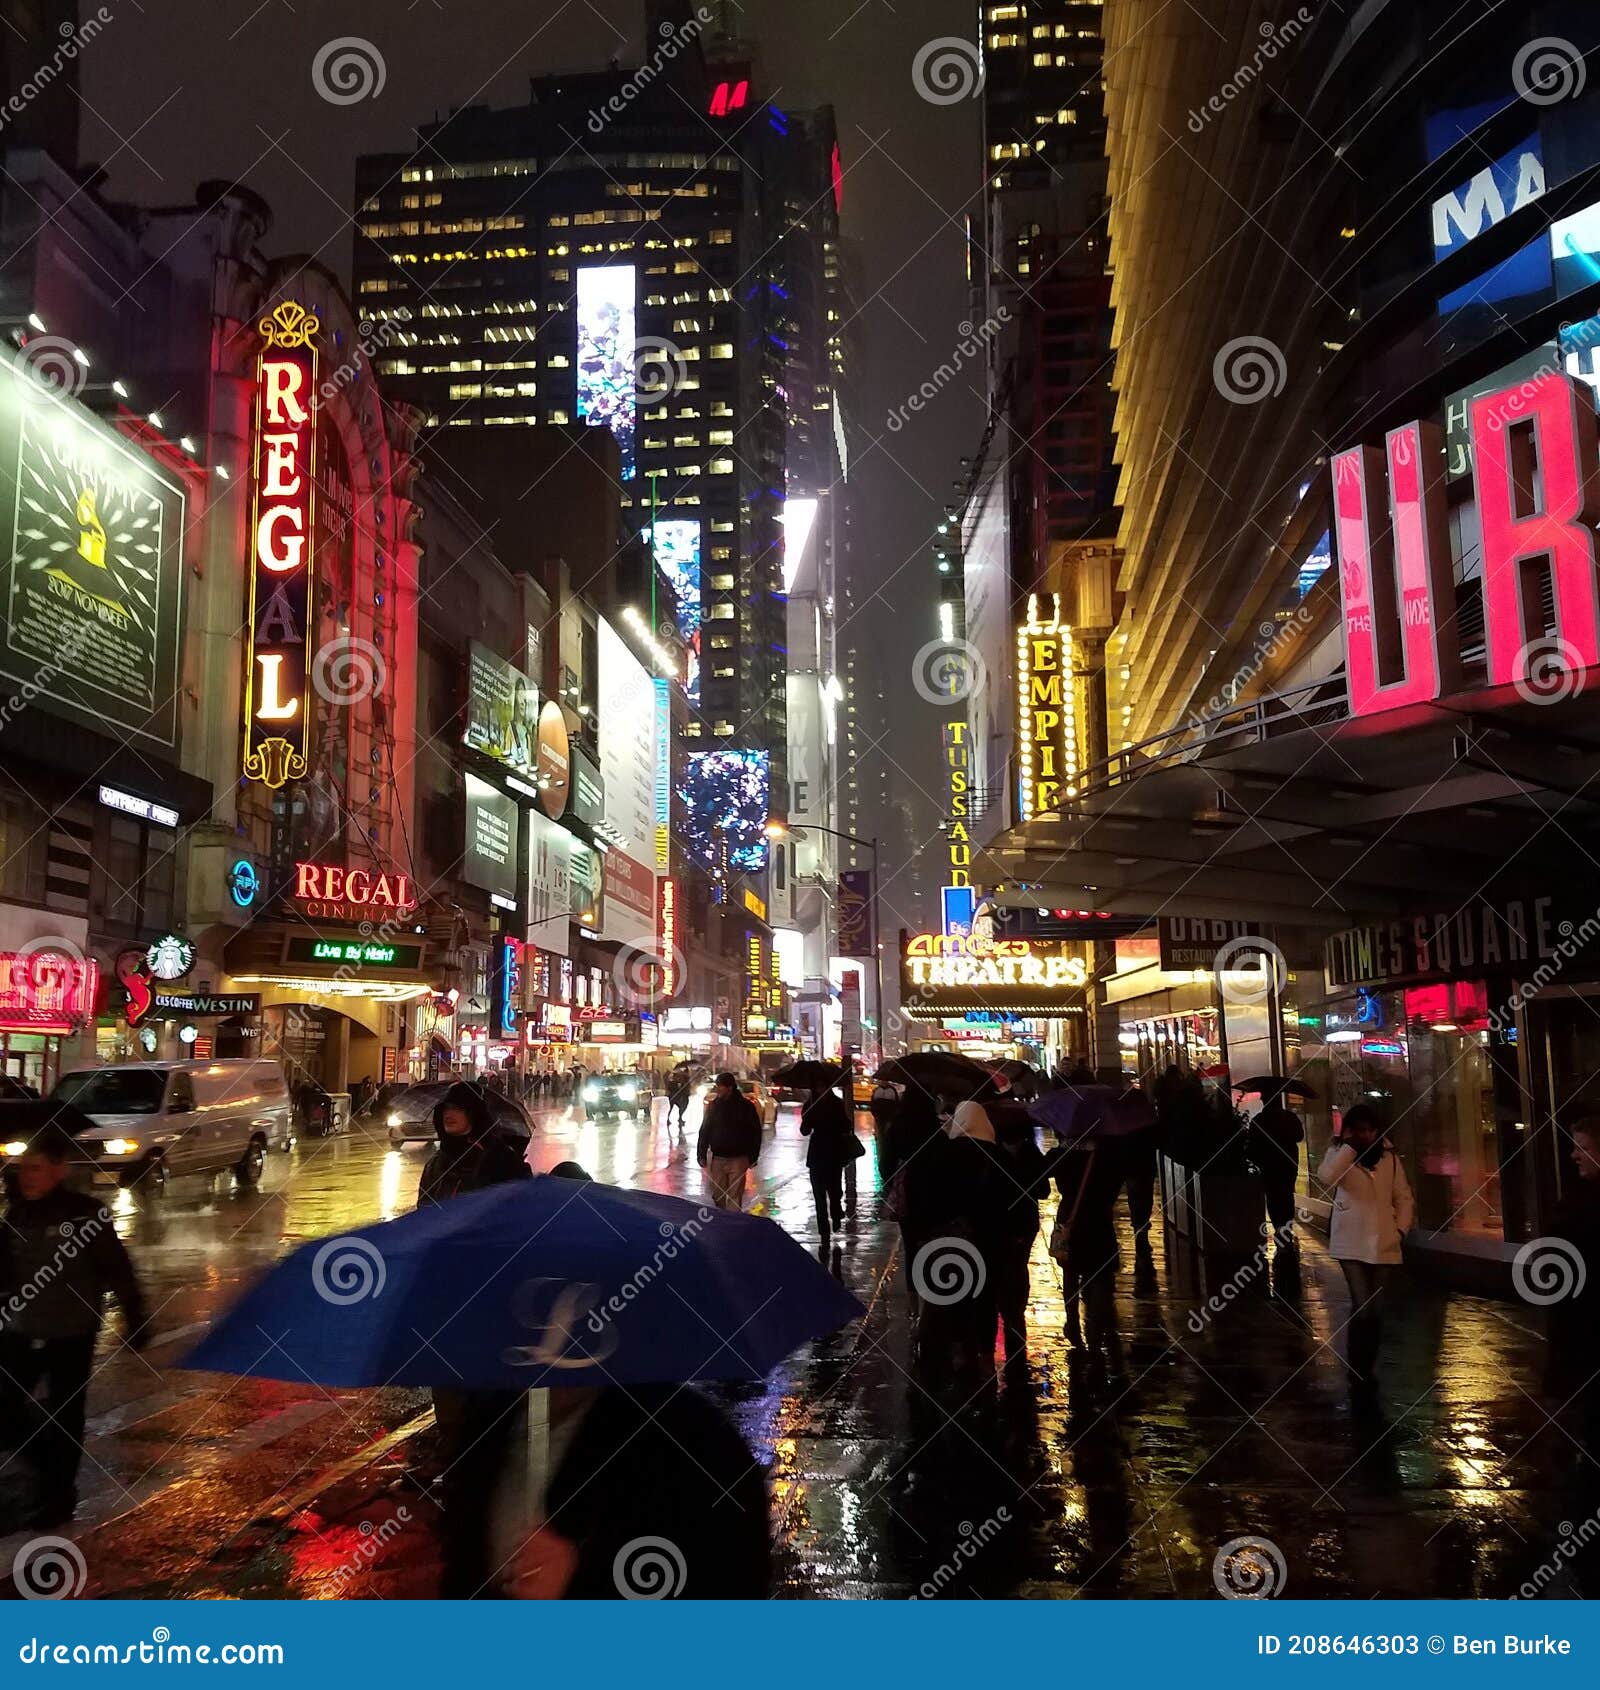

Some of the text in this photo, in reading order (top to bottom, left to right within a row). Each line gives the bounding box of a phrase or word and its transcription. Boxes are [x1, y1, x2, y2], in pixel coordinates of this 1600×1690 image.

[256, 361, 309, 720] REGAL
[295, 862, 416, 908] REGAL
[906, 955, 1088, 988] THEATRES
[193, 998, 254, 1012] WESTIN
